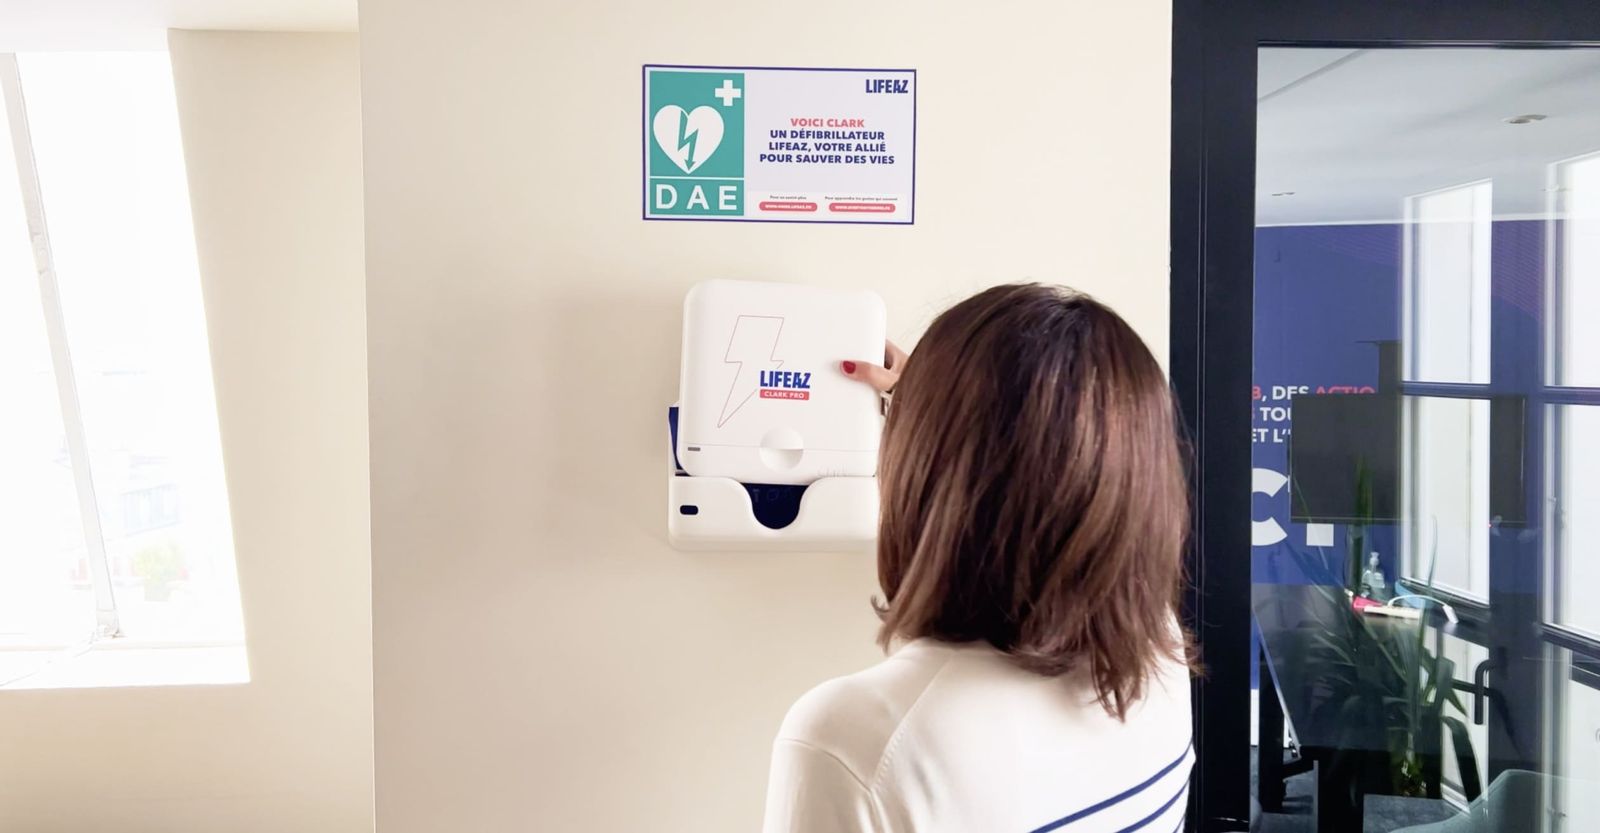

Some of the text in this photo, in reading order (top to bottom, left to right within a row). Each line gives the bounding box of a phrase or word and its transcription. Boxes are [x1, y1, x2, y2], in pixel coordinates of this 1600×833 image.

[865, 79, 909, 94] LIFEAZ
[790, 118, 865, 128] VOICI CLARK
[770, 128, 885, 140] UN DÉFIBRILLATEUR
[769, 141, 886, 153] LIFEAZ, VOTRE ALLIÉ
[760, 154, 895, 164] POUR SAUVER DES VIES
[655, 183, 738, 211] DAE
[760, 370, 811, 389] LIFEAZ
